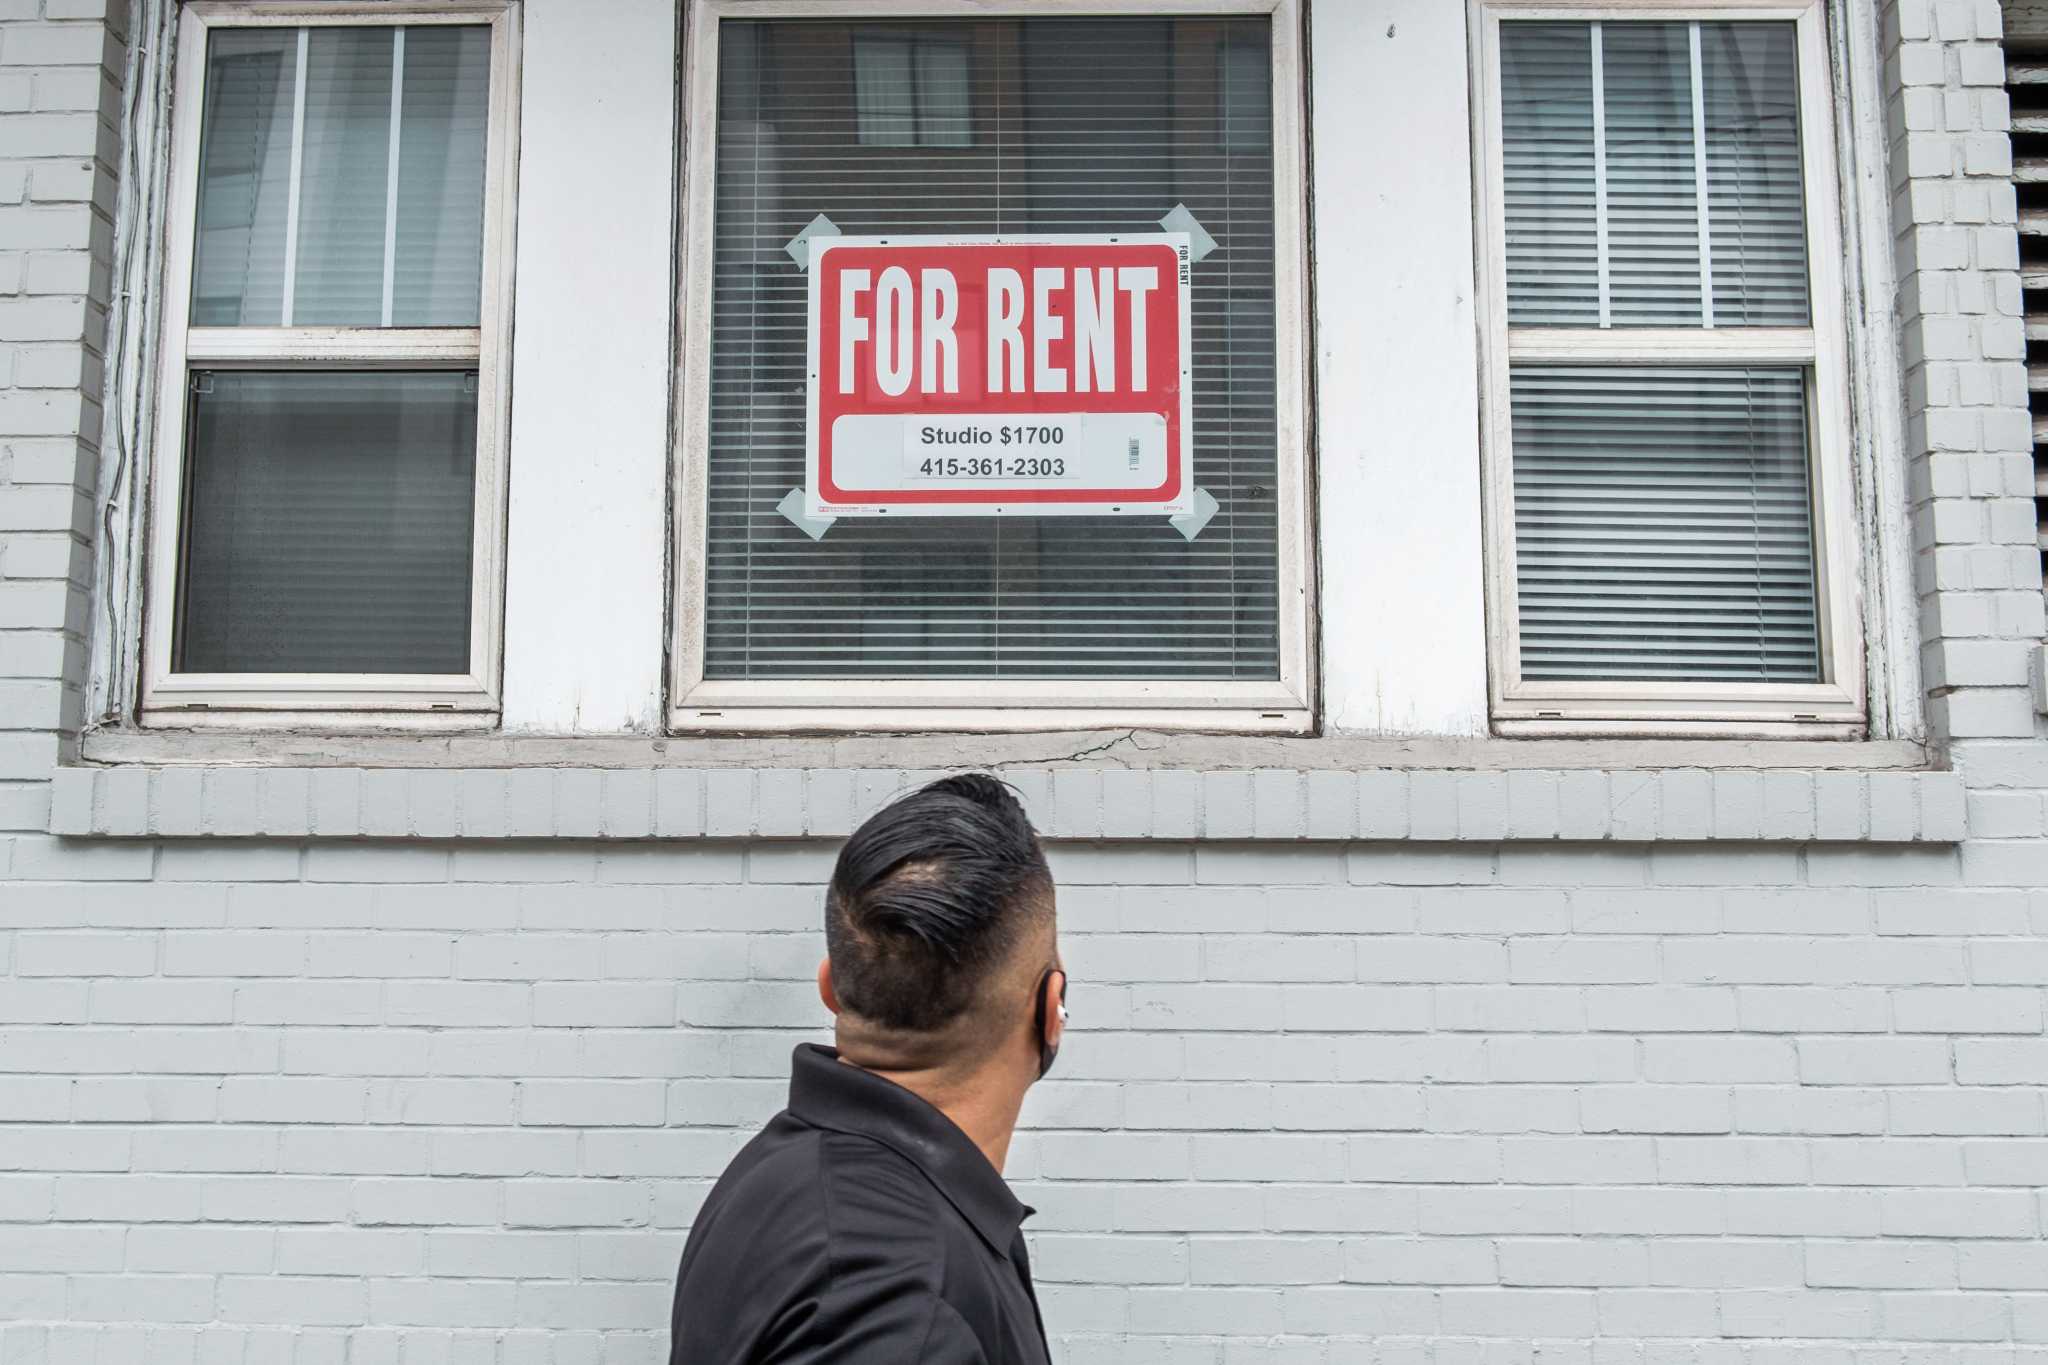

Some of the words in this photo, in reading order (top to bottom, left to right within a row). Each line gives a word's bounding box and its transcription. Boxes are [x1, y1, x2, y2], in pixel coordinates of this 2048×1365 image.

[1179, 245, 1189, 261] FOR
[1180, 264, 1189, 286] RENT
[839, 265, 959, 397] FOR
[987, 266, 1159, 393] RENT
[921, 427, 993, 444] Studio
[1000, 426, 1064, 446] $1700
[920, 458, 1065, 476] 415-361-2303
